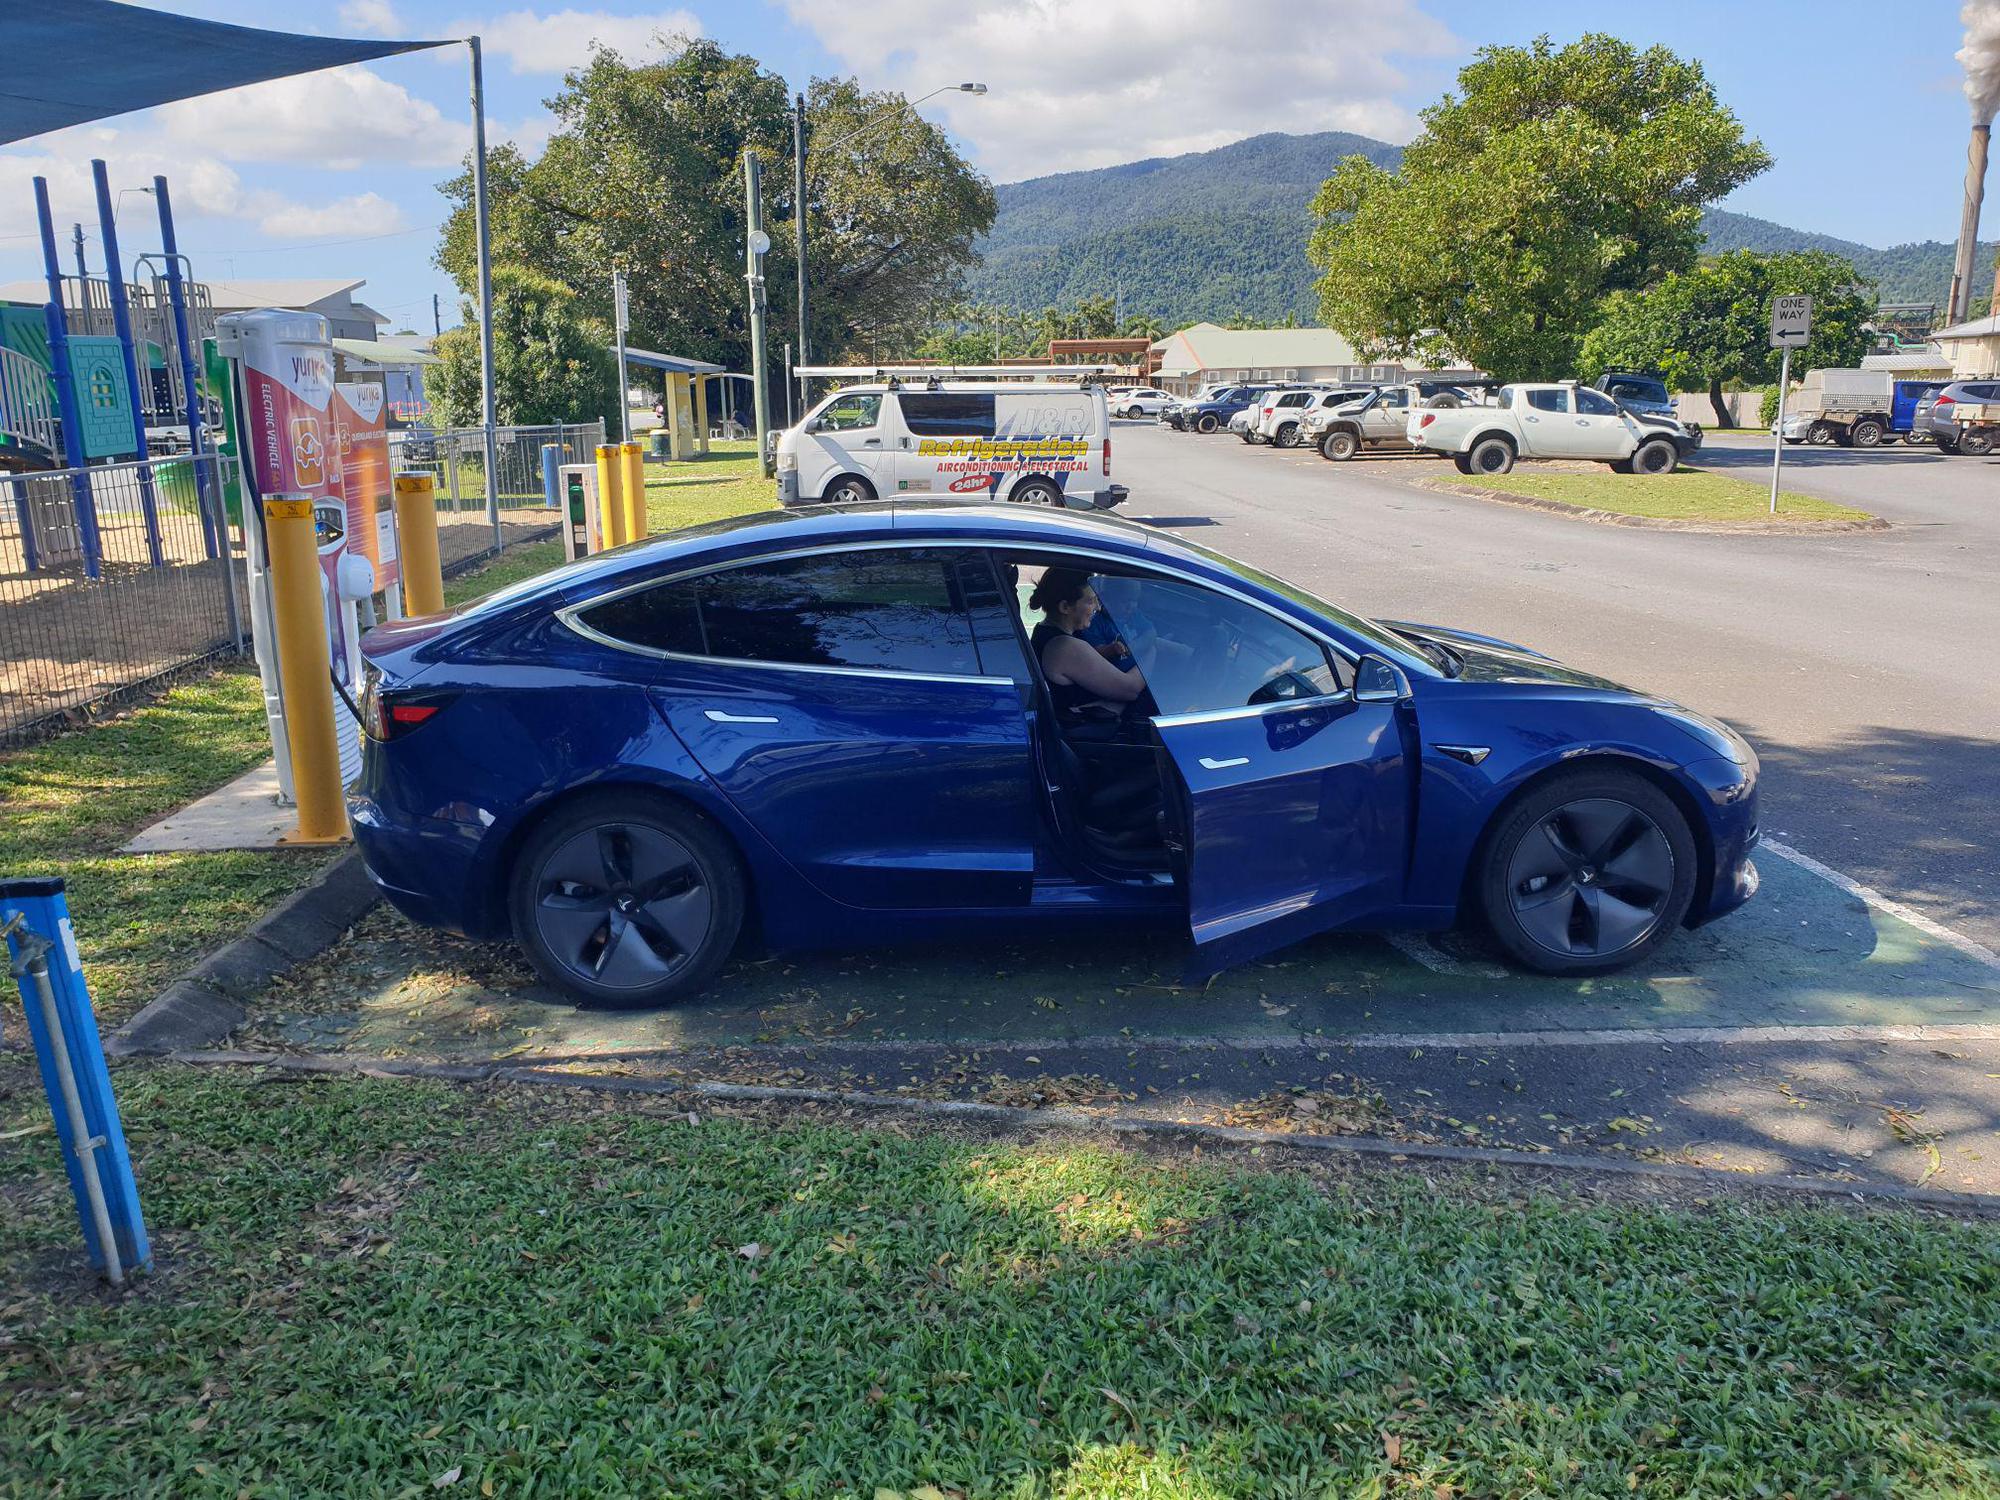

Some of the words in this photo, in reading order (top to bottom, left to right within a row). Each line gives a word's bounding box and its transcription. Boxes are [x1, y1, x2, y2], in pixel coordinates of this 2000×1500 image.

[1780, 298, 1805, 309] ONE
[1780, 310, 1805, 320] WAY
[262, 383, 275, 429] ELECTRIC
[266, 429, 279, 470] VEHICLE
[918, 438, 1088, 459] Refrigeration
[937, 462, 1020, 472] AIRCONDITIONING
[1030, 461, 1089, 471] ELECTRICAL
[955, 478, 986, 491] 24hr
